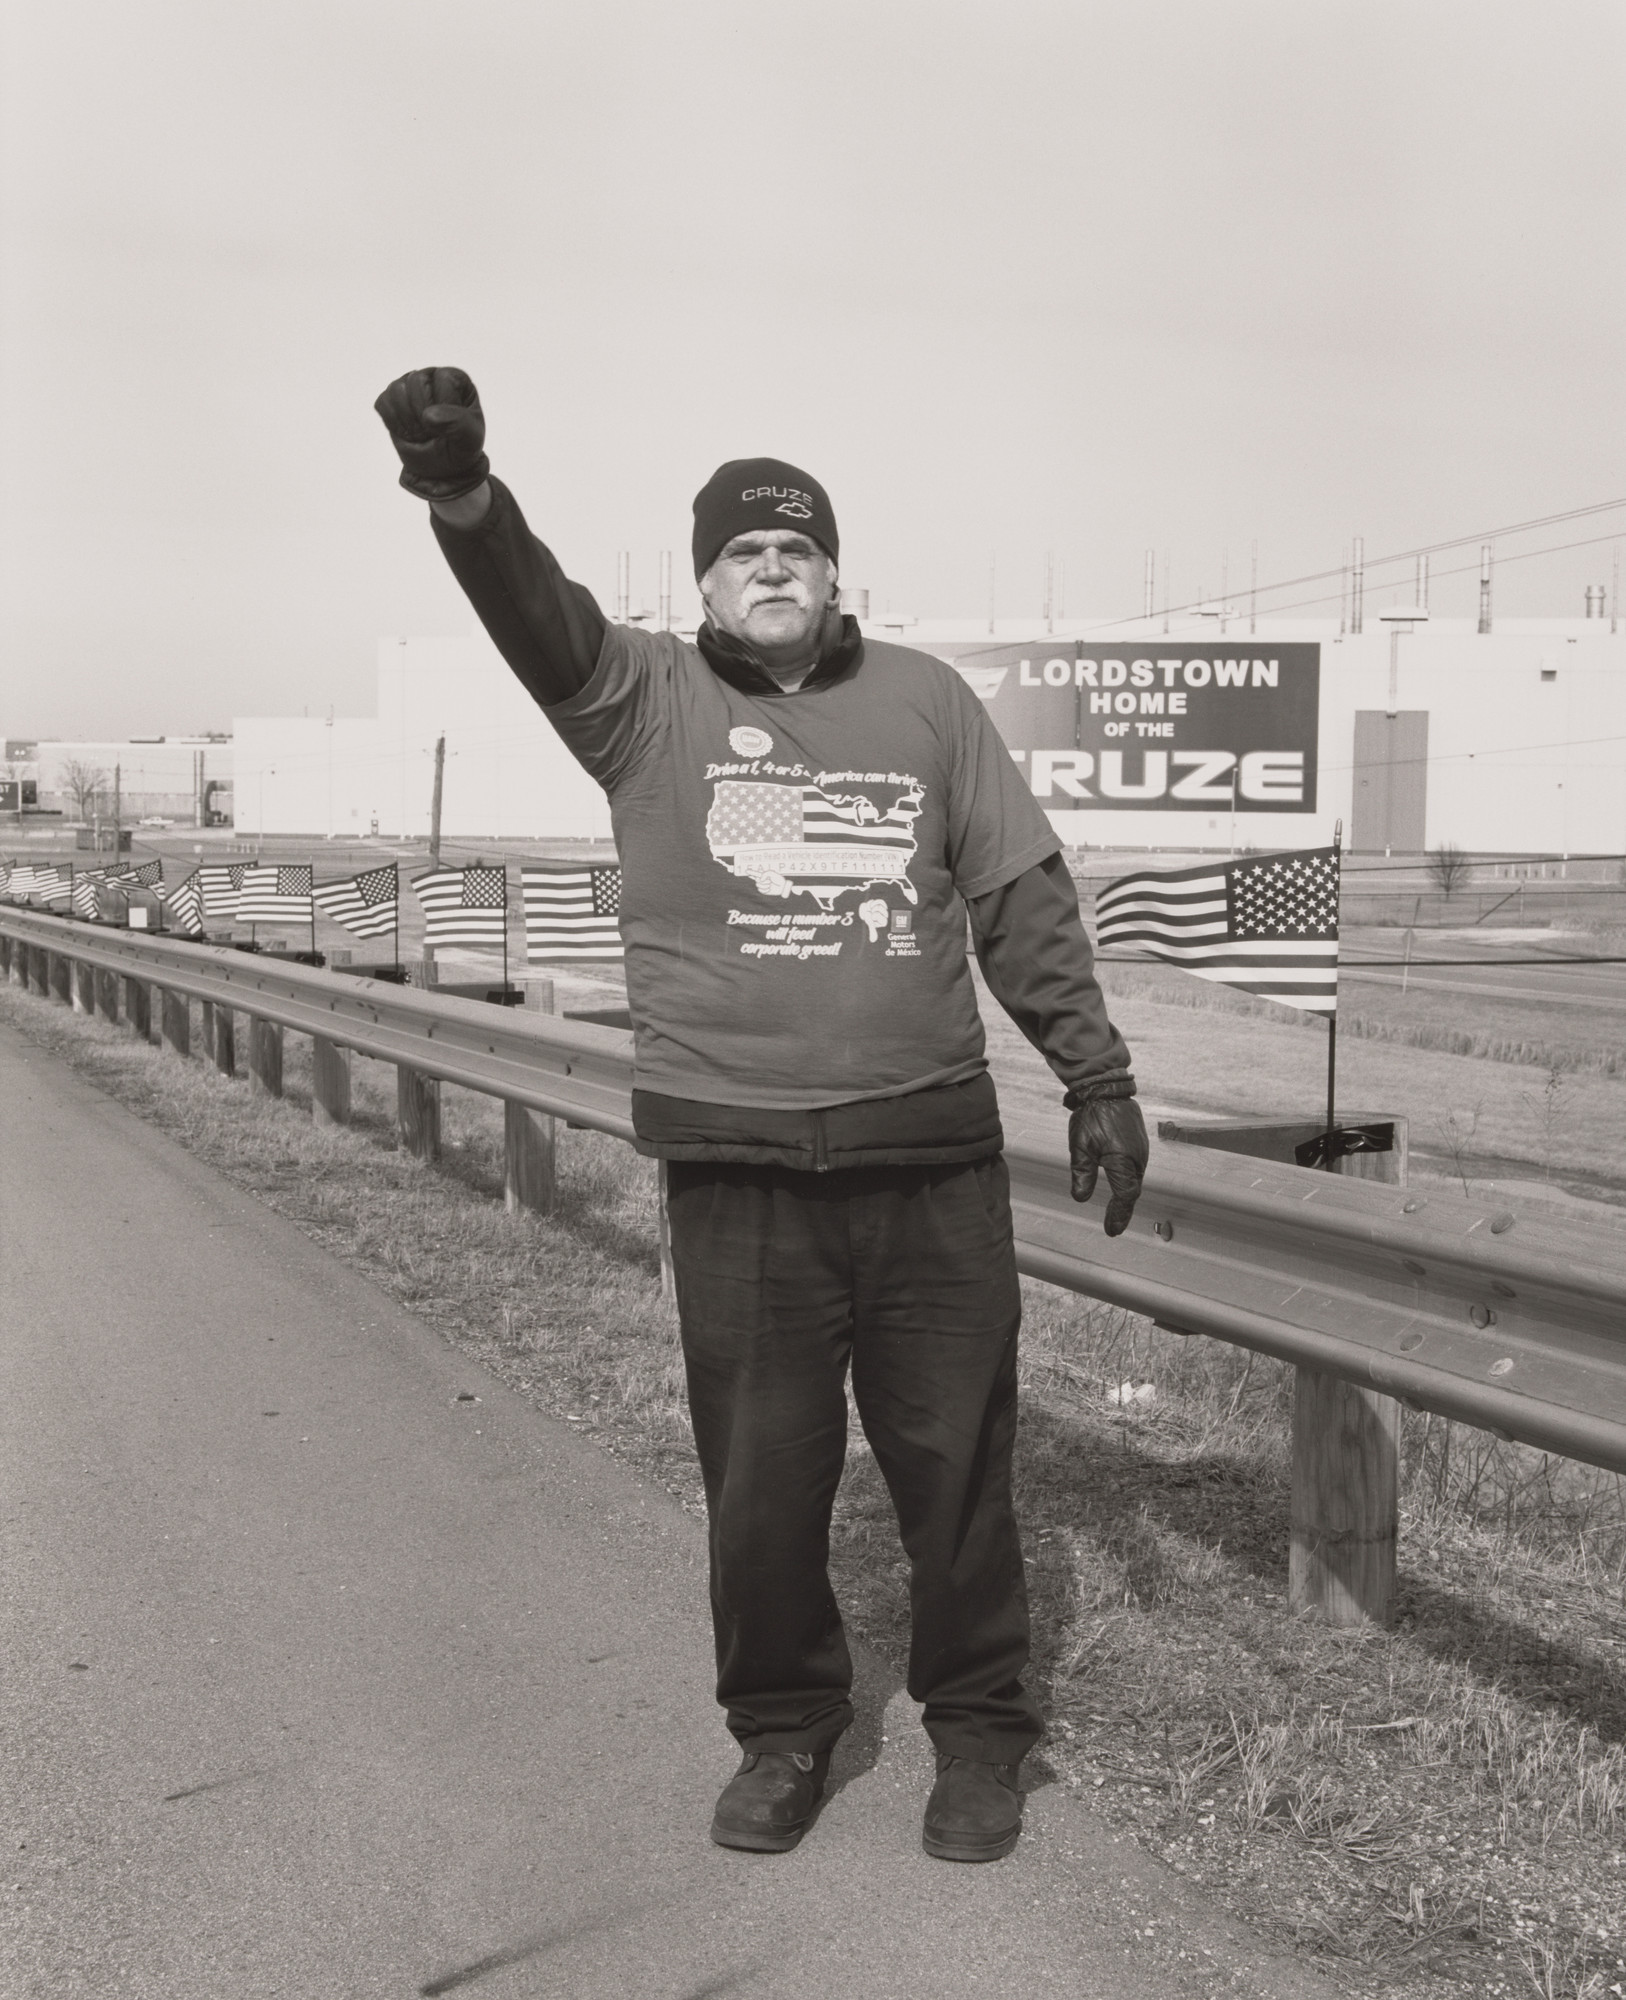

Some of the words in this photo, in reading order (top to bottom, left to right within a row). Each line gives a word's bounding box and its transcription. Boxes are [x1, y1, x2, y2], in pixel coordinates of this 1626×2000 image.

[742, 486, 813, 506] CRUZE
[1019, 659, 1279, 687] LORDSTOWN
[1090, 692, 1188, 715] HOME
[1103, 722, 1130, 737] OF
[1135, 722, 1174, 738] THE
[703, 762, 739, 779] Drive
[762, 761, 775, 775] 4
[775, 766, 791, 775] or
[790, 763, 804, 777] 5
[813, 770, 864, 787] America
[864, 772, 886, 783] can
[1009, 750, 1304, 801] RUZE
[763, 851, 781, 861] Read
[787, 851, 811, 860] Vehicle
[813, 851, 858, 860] Identification
[859, 852, 883, 860] Number
[726, 909, 781, 925] Because
[781, 914, 792, 925] a
[792, 912, 841, 925] number
[841, 911, 854, 926] 3
[765, 927, 789, 940] will
[787, 926, 817, 944] feed
[887, 932, 916, 941] General
[740, 942, 801, 959] corporate
[885, 948, 895, 956] de
[897, 948, 921, 956] México
